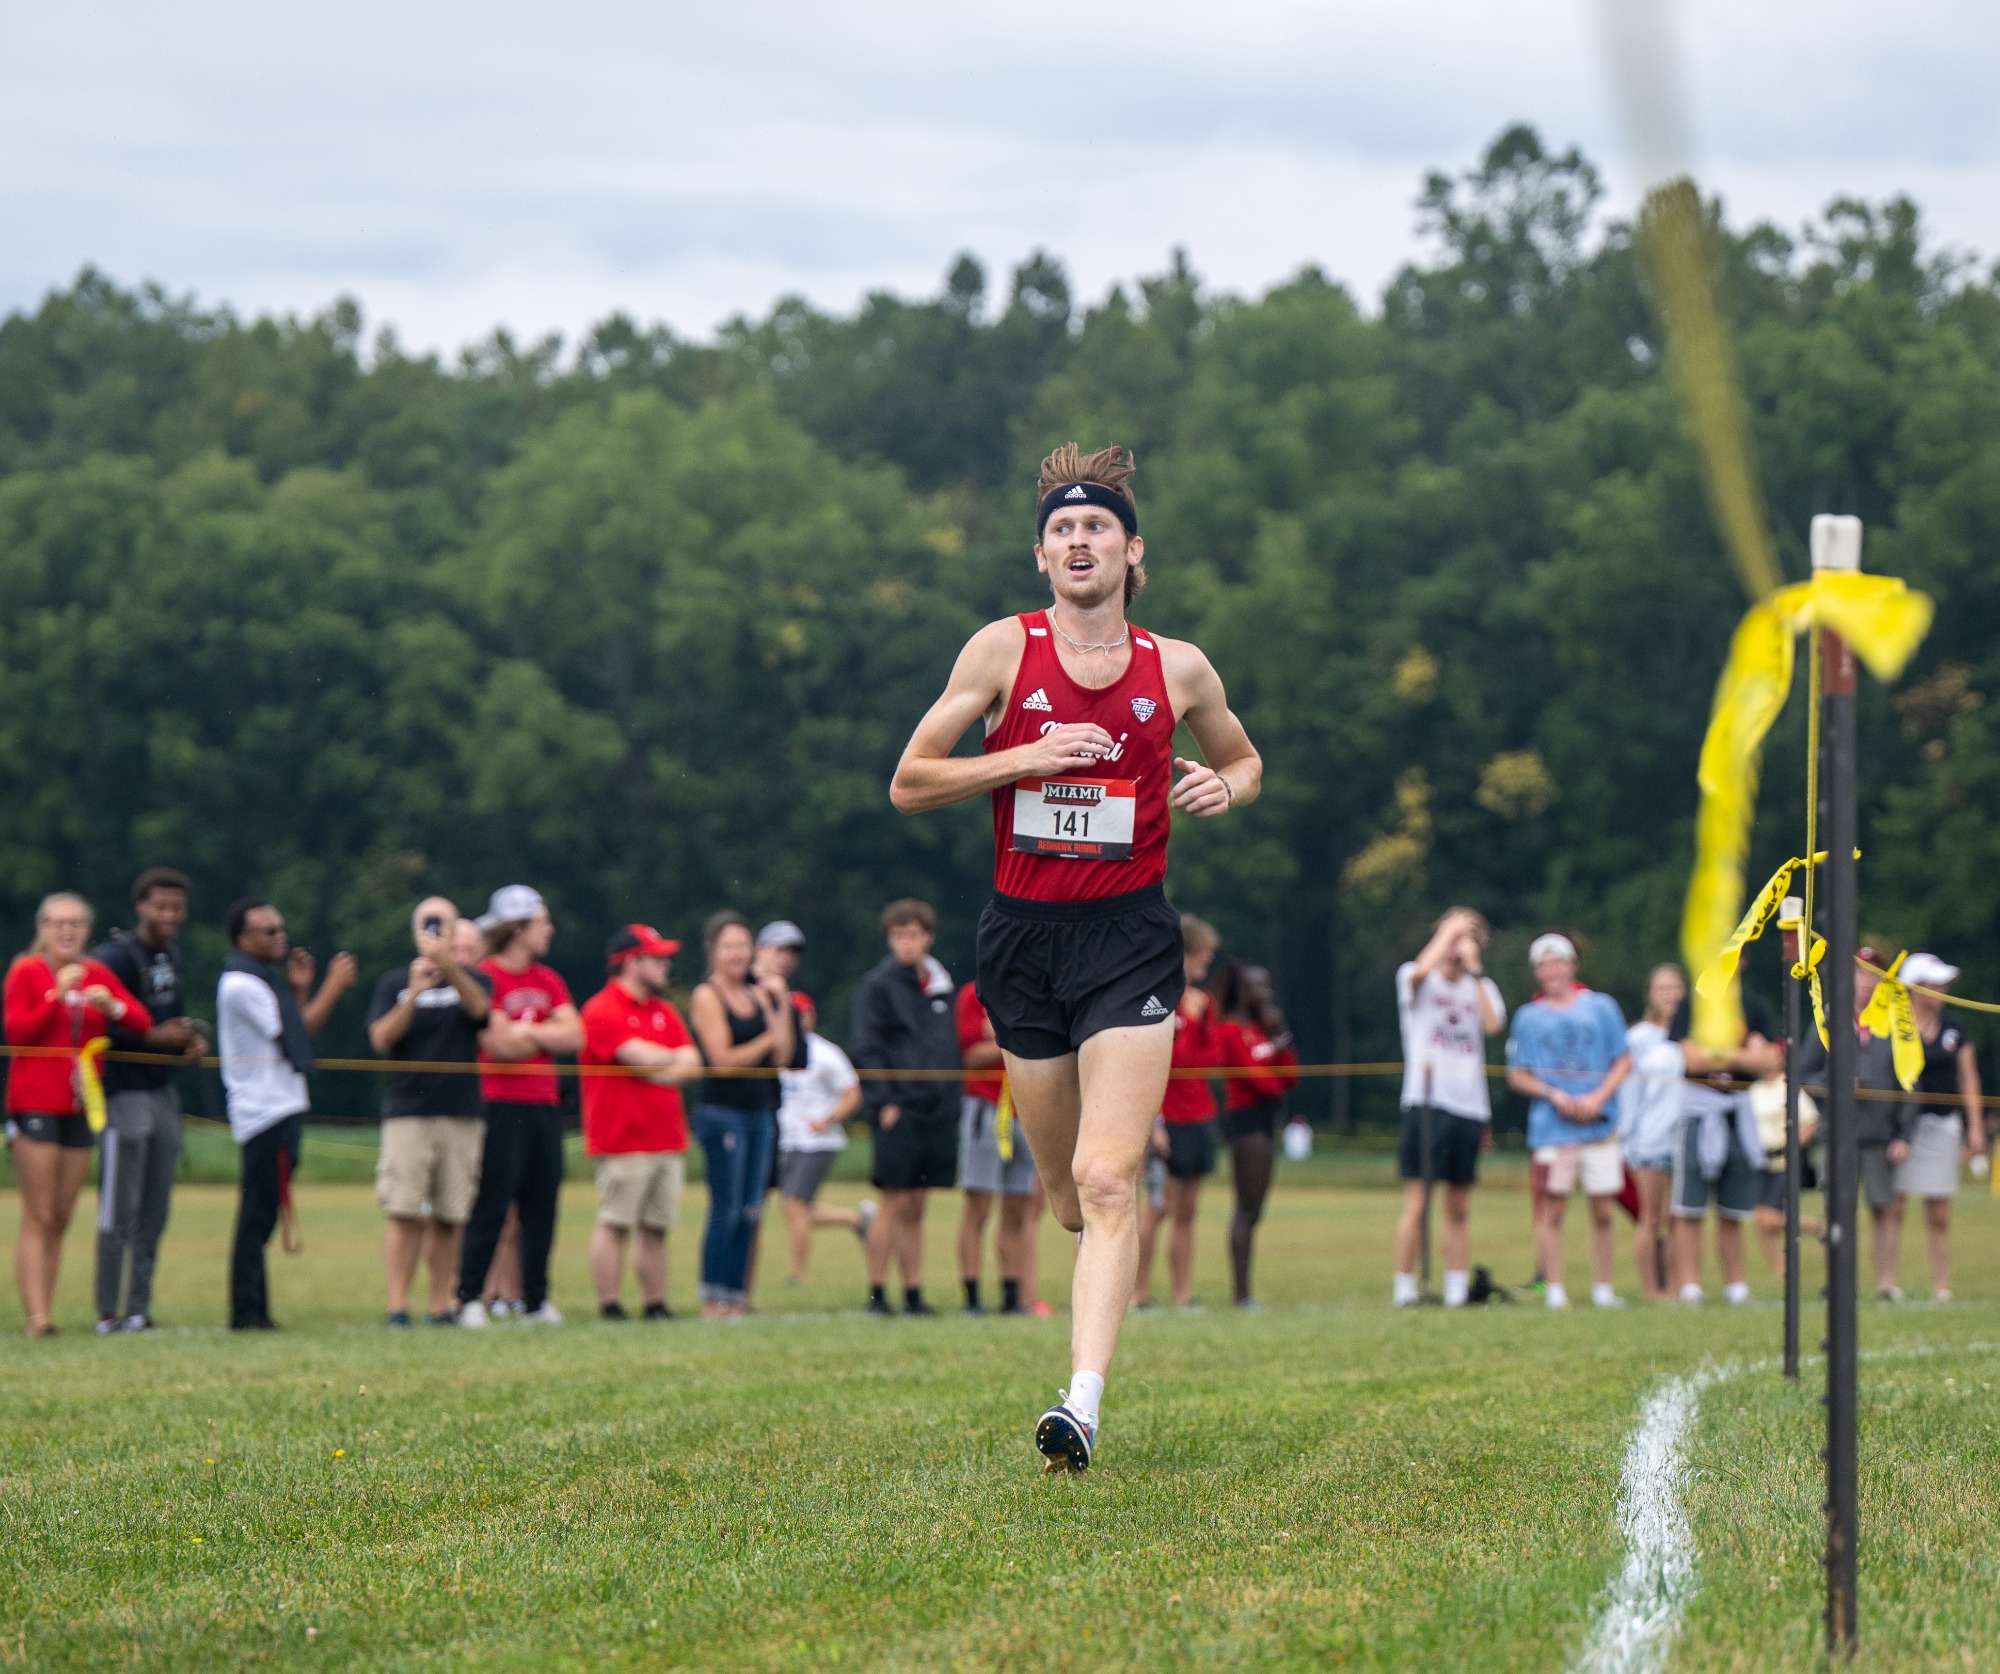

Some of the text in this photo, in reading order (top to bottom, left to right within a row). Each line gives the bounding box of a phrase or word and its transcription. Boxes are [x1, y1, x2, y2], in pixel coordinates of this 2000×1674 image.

[1022, 701, 1053, 712] adidas
[1132, 704, 1155, 714] MAC
[1047, 785, 1100, 800] MIAMI
[1053, 809, 1089, 837] 141
[1038, 840, 1103, 854] REDHAWK RUMBLE
[1141, 1008, 1168, 1016] adidas
